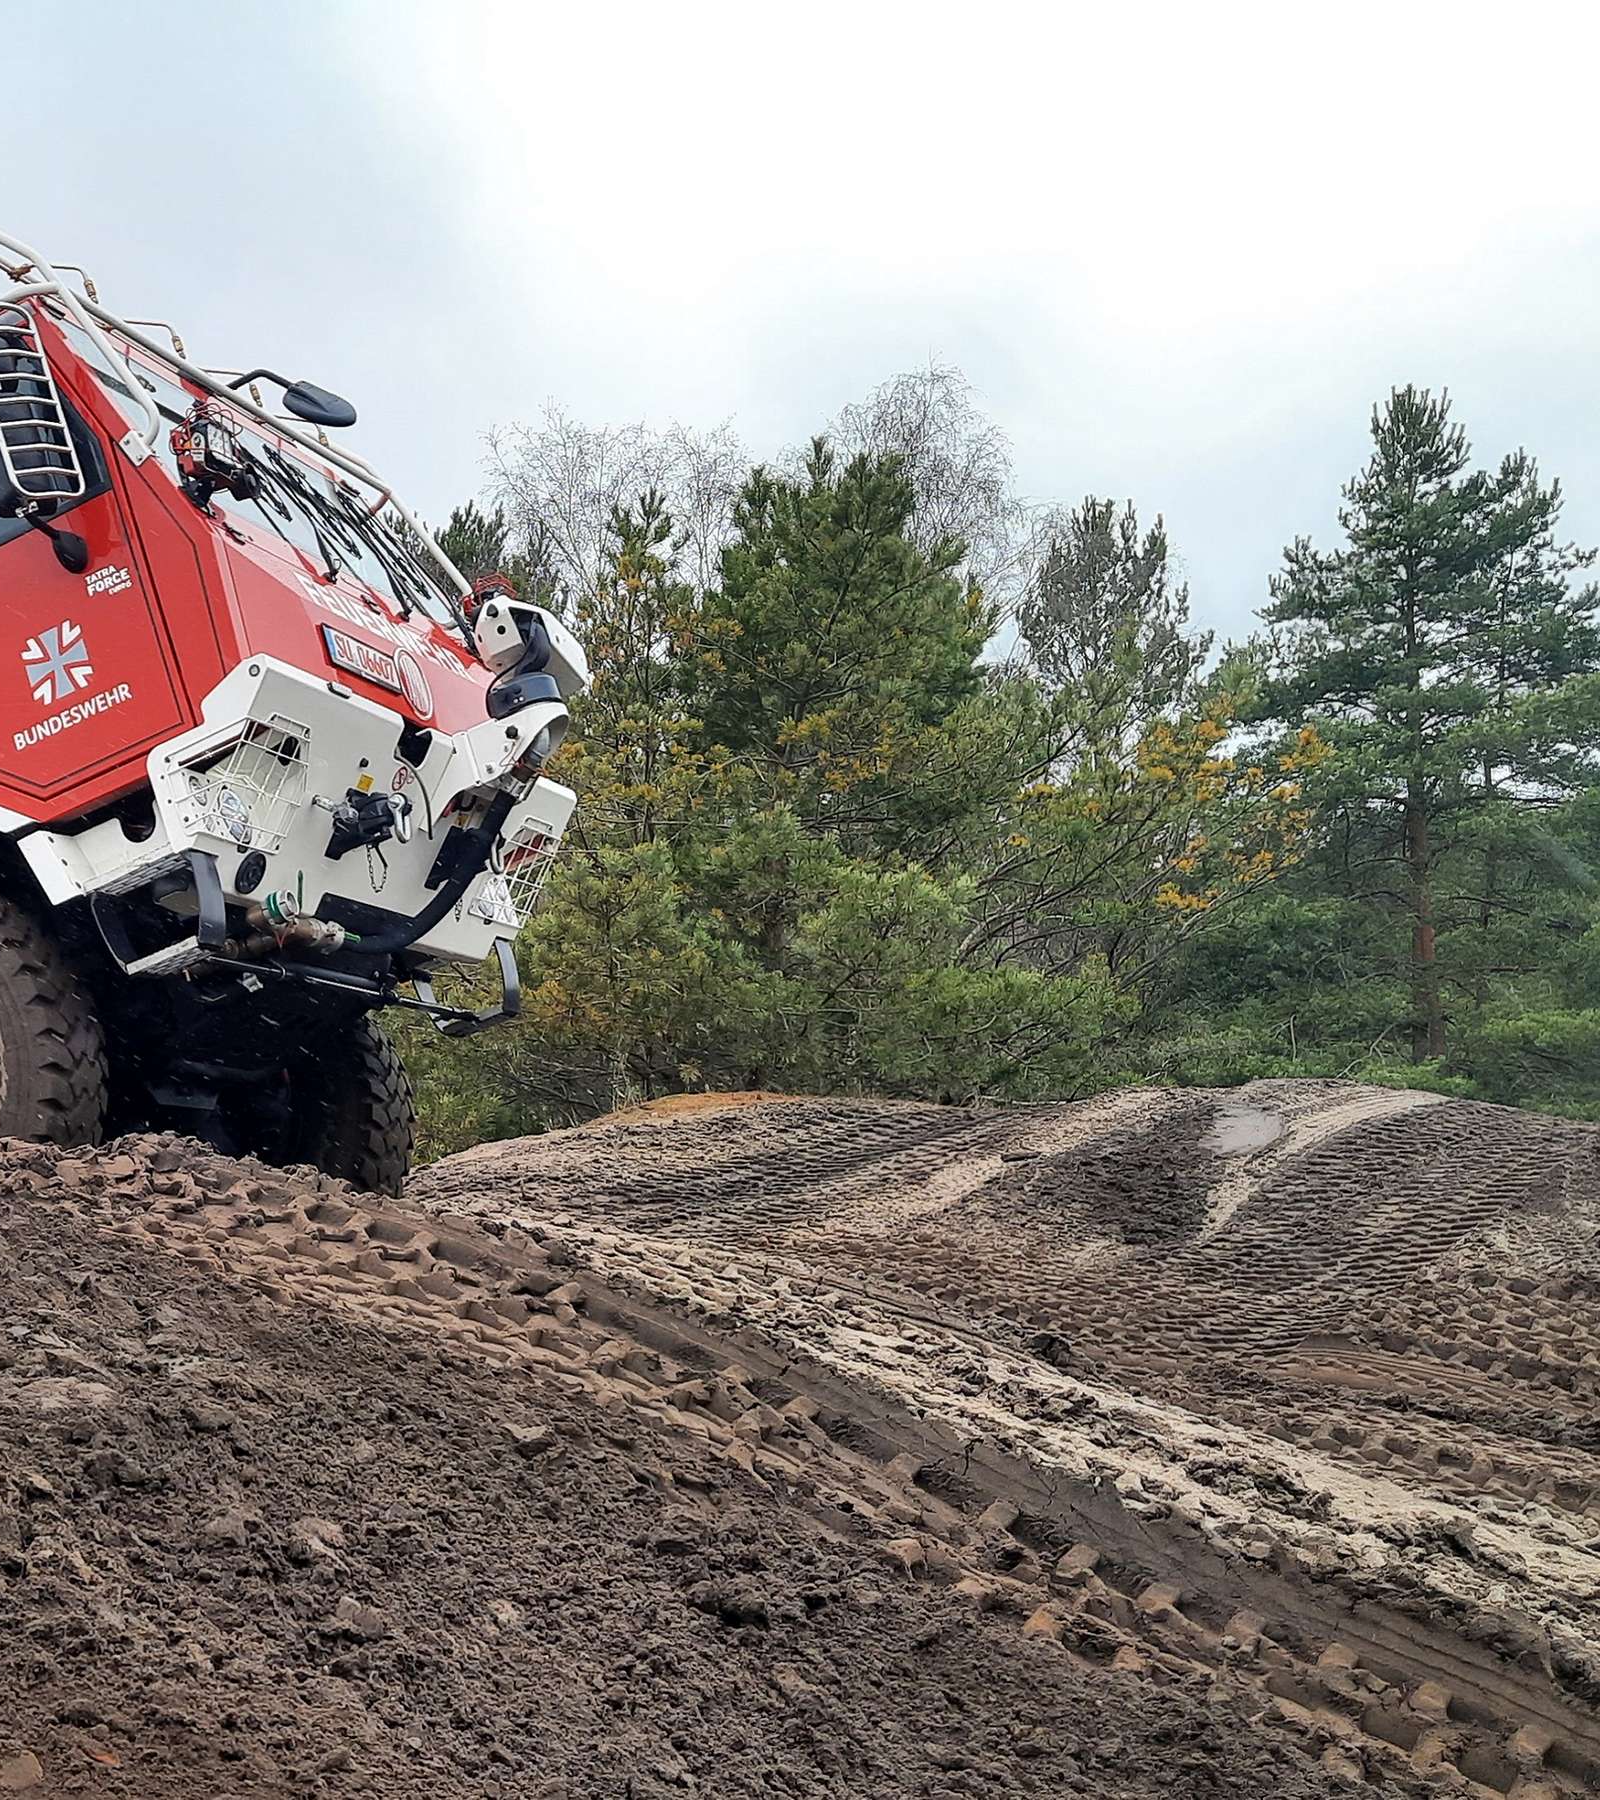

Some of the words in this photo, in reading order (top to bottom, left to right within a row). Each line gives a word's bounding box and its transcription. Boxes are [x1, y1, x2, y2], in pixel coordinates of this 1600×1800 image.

[85, 565, 117, 585] TATRA
[87, 567, 131, 597] FORCE
[293, 570, 480, 687] FEUERWEHR
[334, 633, 354, 663] SU
[13, 683, 133, 751] BUNDESWEHR
